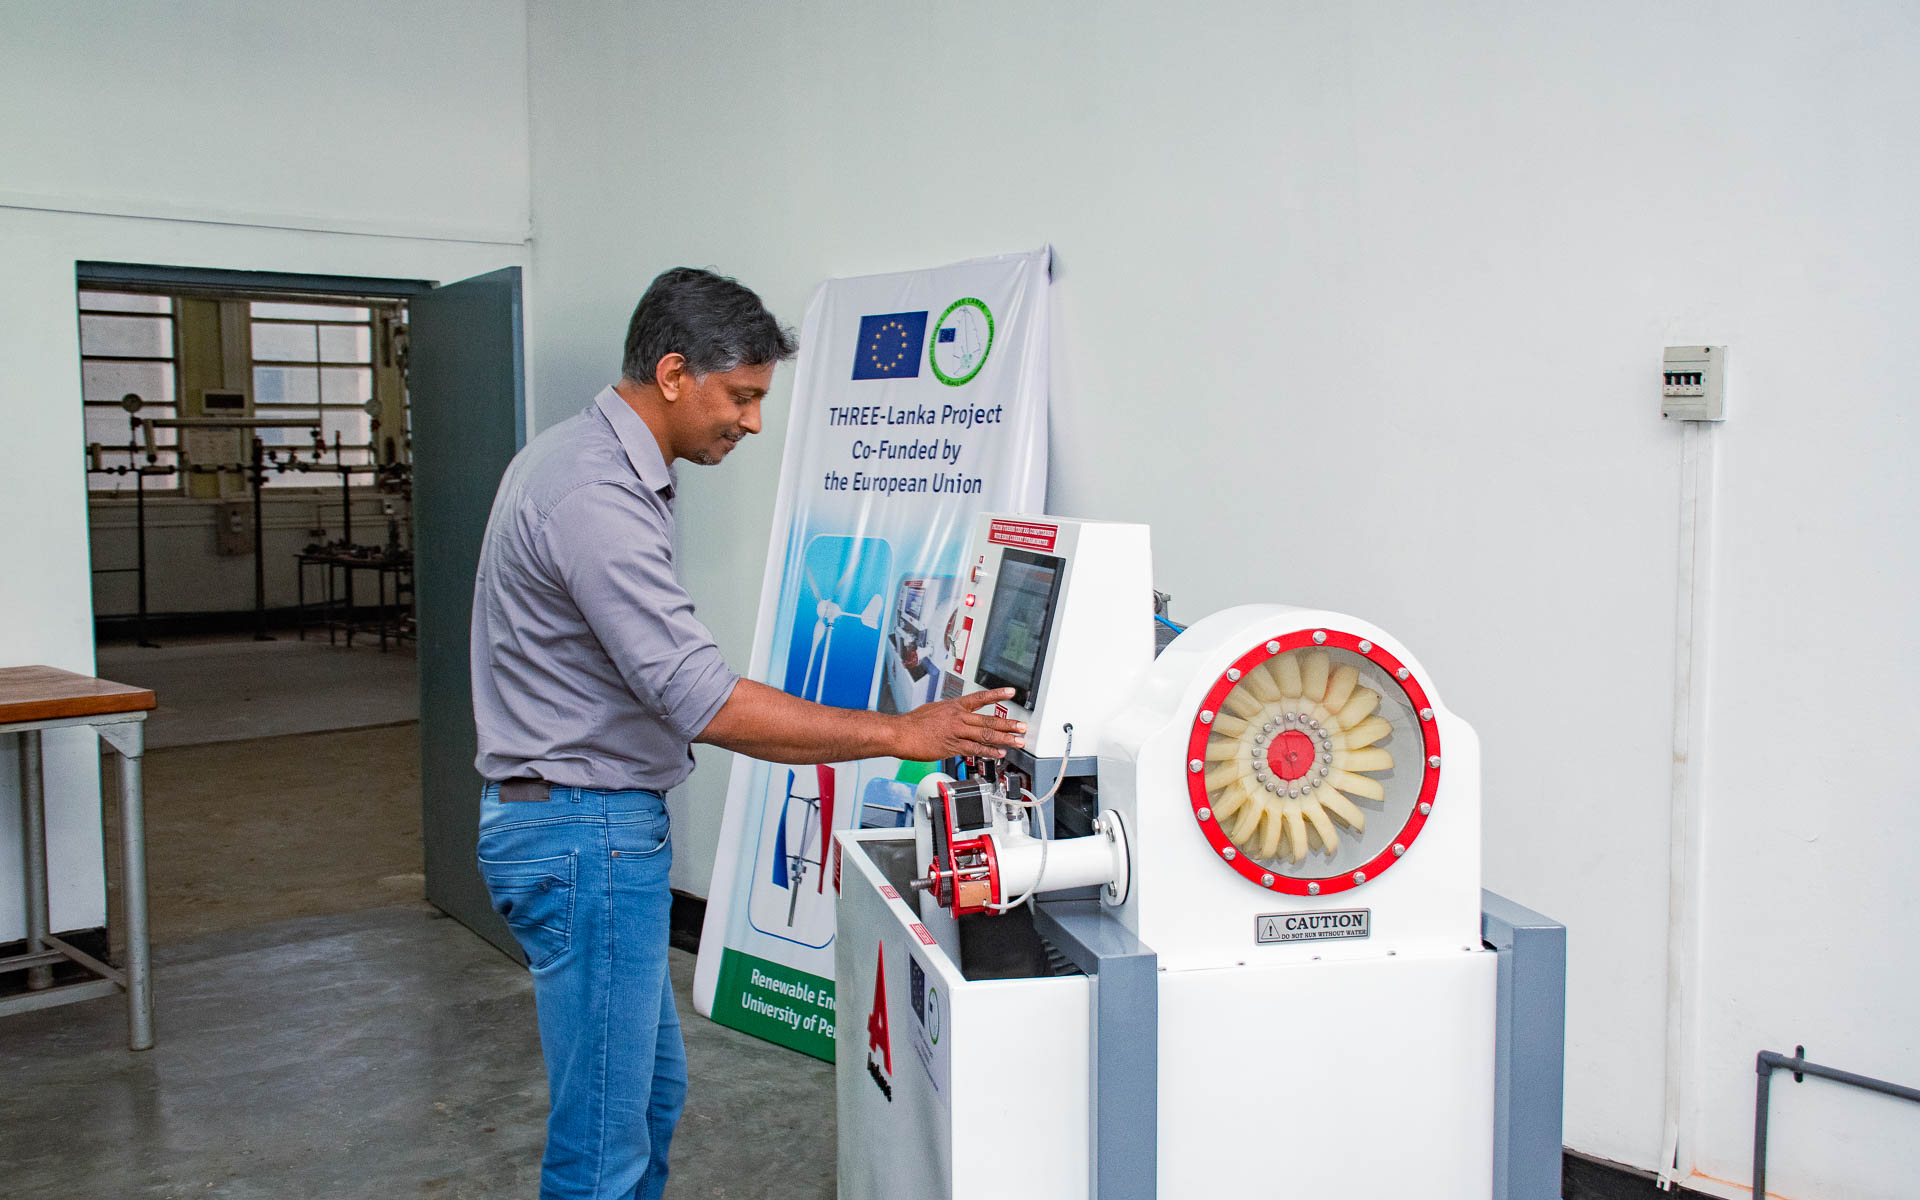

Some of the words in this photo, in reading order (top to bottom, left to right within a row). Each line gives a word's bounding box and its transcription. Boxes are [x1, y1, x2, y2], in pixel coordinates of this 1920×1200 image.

[829, 404, 936, 426] THREE-Lanka
[941, 403, 1003, 429] Project
[852, 439, 939, 460] Co-Funded
[942, 439, 962, 465] by
[824, 470, 848, 490] the
[852, 472, 928, 497] European
[932, 473, 982, 494] Union
[1285, 914, 1364, 931] CAUTION
[750, 968, 815, 1004] Renewable
[741, 992, 801, 1030] University
[803, 1014, 818, 1032] of
